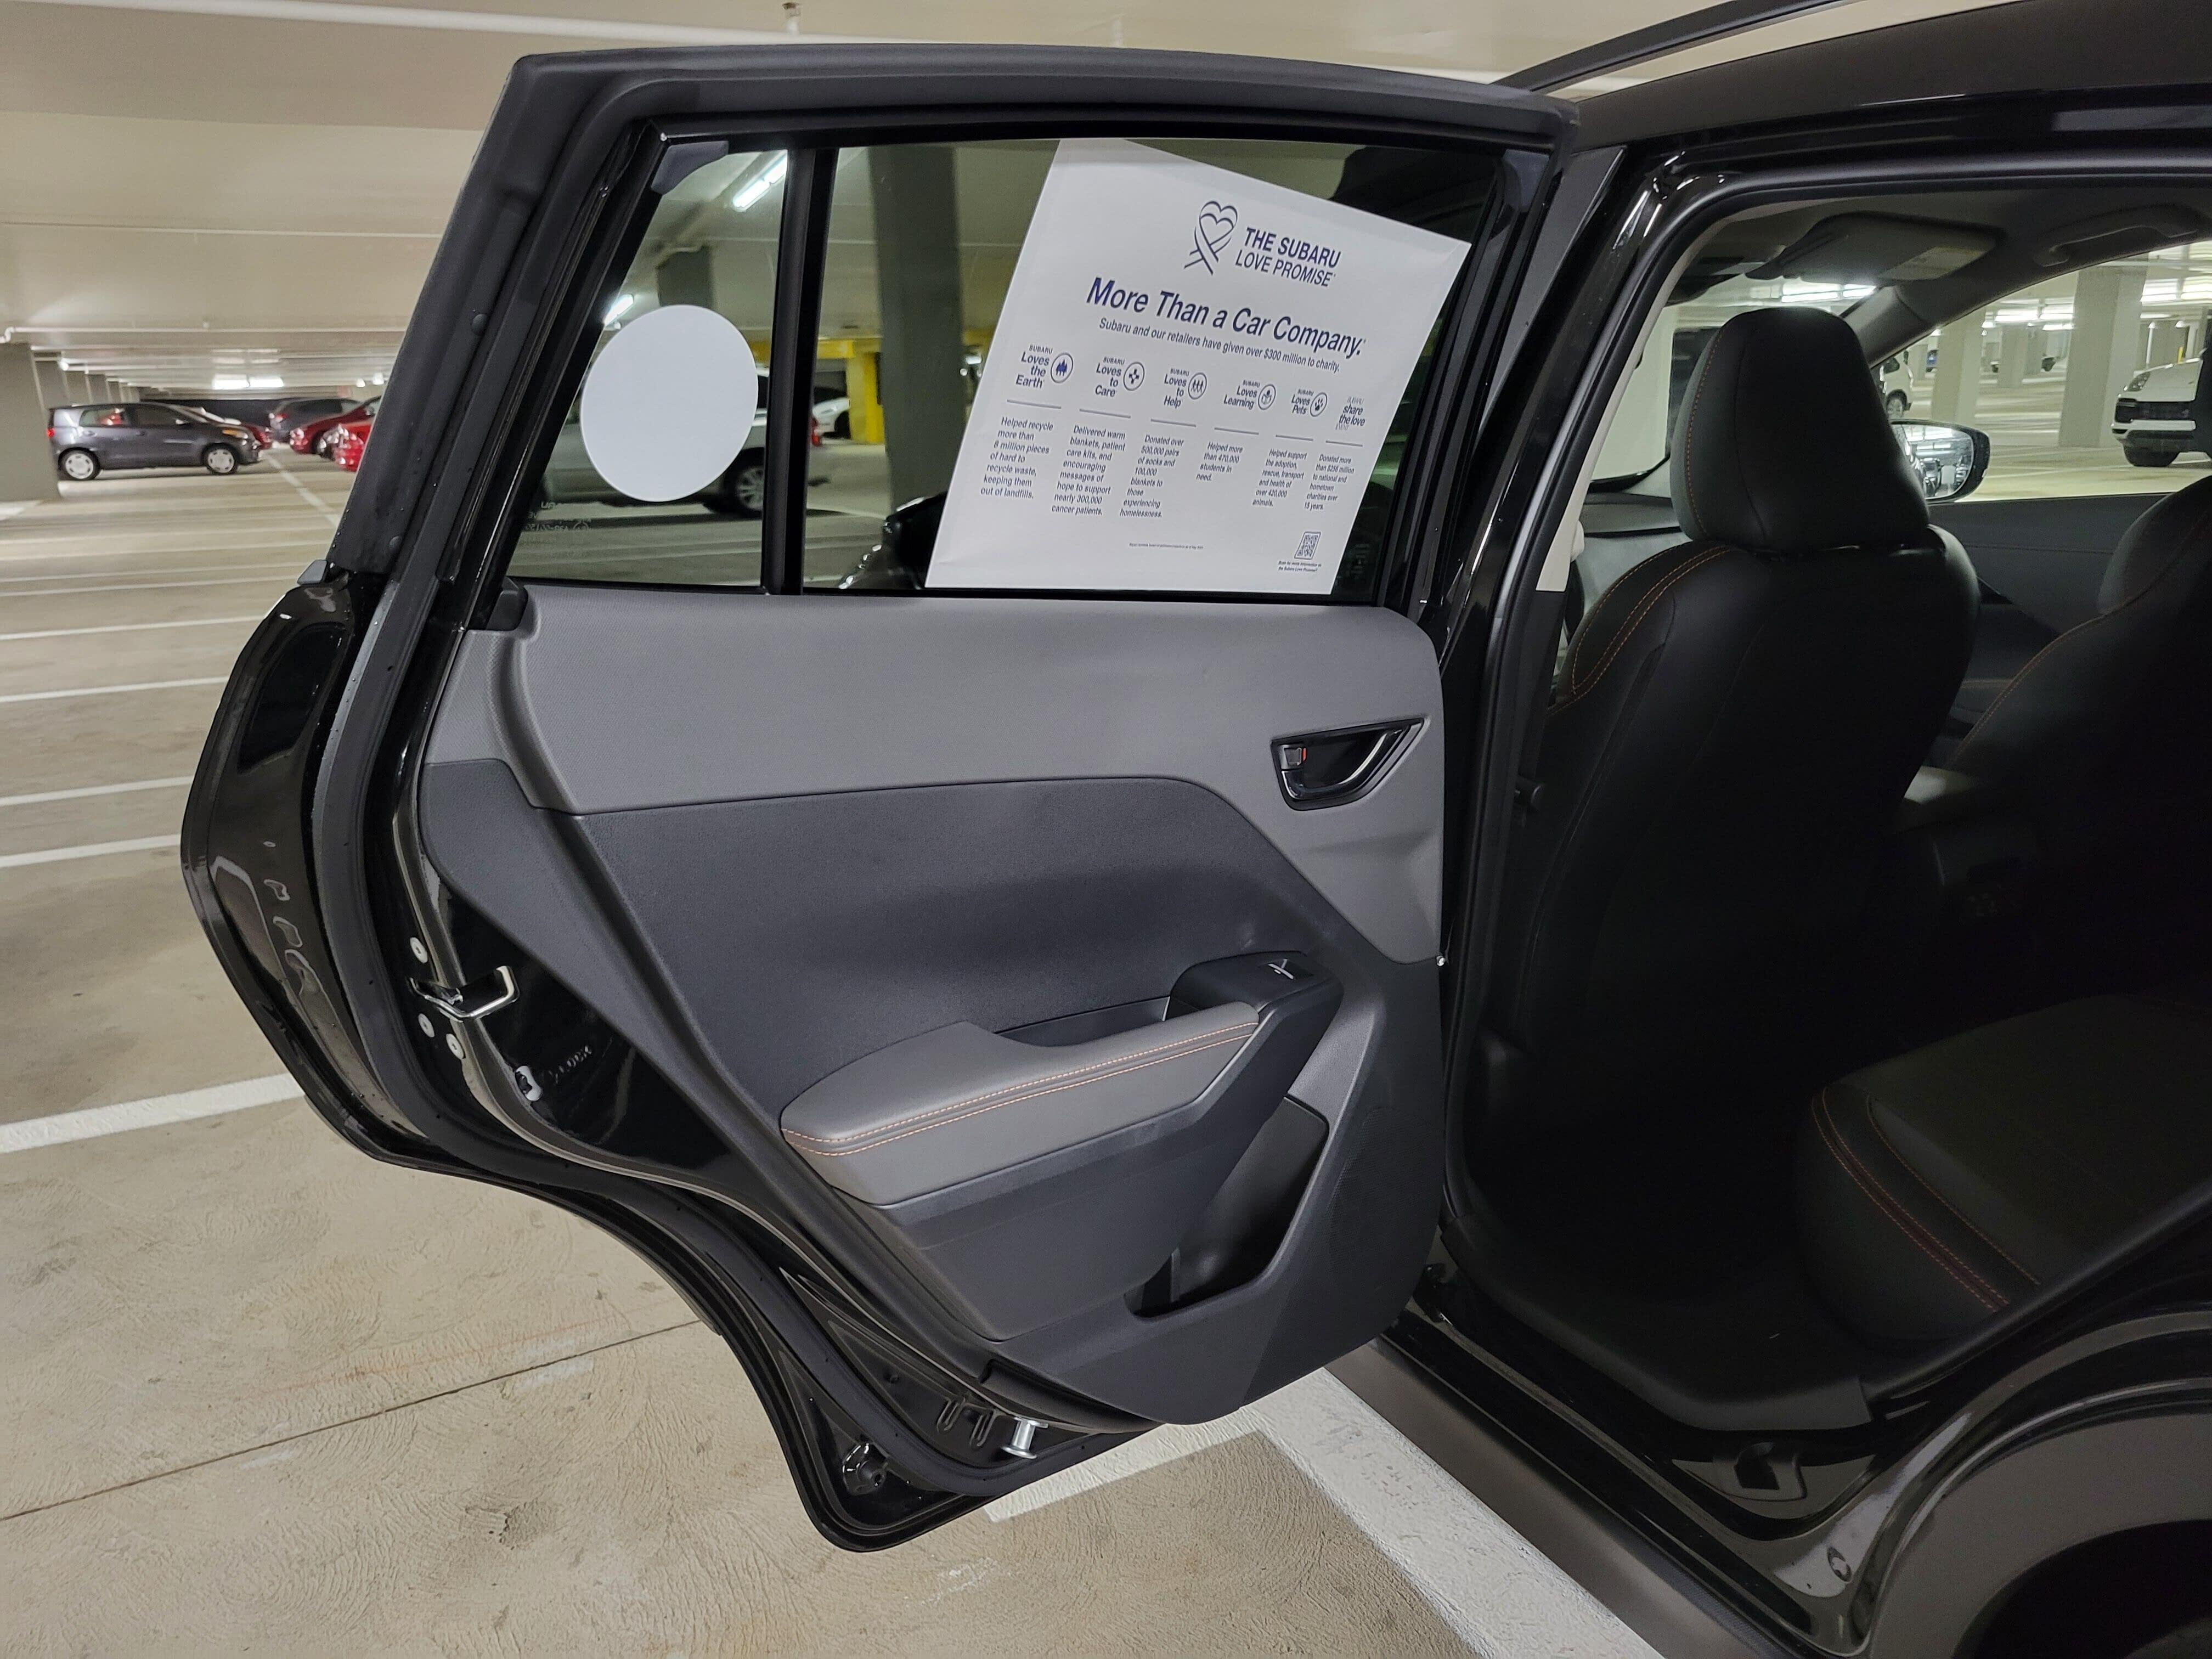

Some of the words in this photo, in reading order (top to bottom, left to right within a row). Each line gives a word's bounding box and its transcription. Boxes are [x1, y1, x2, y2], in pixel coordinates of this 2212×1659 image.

[1245, 227, 1276, 251] THE
[1278, 237, 1341, 268] SUBARU
[1235, 250, 1272, 273] LOVE
[1273, 259, 1333, 286] PROMISE
[1086, 277, 1149, 313] More
[1156, 291, 1209, 324] Than
[1212, 310, 1228, 328] a
[1233, 308, 1271, 336] Car
[1273, 317, 1362, 359] Company.
[1029, 345, 1053, 354] SUBARU
[1099, 317, 1131, 333] Subaru
[1133, 326, 1150, 336] and
[1151, 329, 1166, 339] our
[1167, 332, 1200, 346] retailers
[1202, 336, 1221, 349] have
[1222, 341, 1244, 353] given
[1246, 346, 1263, 357] over
[1264, 348, 1282, 360] $300
[1282, 353, 1306, 365] million
[1308, 357, 1314, 366] to
[1316, 358, 1340, 374] charity.
[1021, 351, 1049, 366] Loves
[1103, 357, 1125, 365] SUBARU
[1031, 365, 1046, 377] the
[1096, 363, 1121, 377] Loves
[1170, 368, 1189, 376] SUBARU
[1015, 375, 1043, 389] Earth
[1110, 377, 1119, 387] to
[1164, 374, 1187, 387] Loves
[1095, 385, 1115, 397] Care
[1176, 387, 1184, 397] to
[1237, 386, 1257, 398] Loves
[1164, 395, 1181, 408] Help
[1223, 394, 1254, 410] Learning
[1291, 394, 1311, 405] Loves
[1292, 404, 1307, 415] Pets
[1343, 404, 1363, 415] share
[1001, 417, 1027, 427] Helped
[1029, 420, 1053, 432] recycle
[1339, 414, 1350, 425] the
[1350, 415, 1365, 426] love
[998, 430, 1017, 438] more
[1018, 431, 1034, 441] than
[1074, 425, 1106, 437] Delivered
[1107, 431, 1125, 439] warm
[1070, 437, 1100, 448] blankets,
[1102, 441, 1125, 452] patient
[1145, 434, 1170, 445] Donated
[1000, 441, 1025, 452] million
[1026, 444, 1049, 454] pieces
[1165, 447, 1180, 457] pairs
[1207, 441, 1228, 452] Helped
[1000, 453, 1017, 462] hard
[1066, 449, 1081, 457] care
[1083, 450, 1097, 460] kits,
[1098, 452, 1112, 461] and
[1204, 452, 1217, 462] than
[1269, 448, 1288, 459] Helped
[1288, 451, 1307, 461] support
[1319, 454, 1339, 464] Donated
[1063, 460, 1106, 473] encouraging
[1138, 456, 1146, 465] of
[1146, 458, 1163, 466] socks
[1164, 459, 1176, 467] and
[1266, 458, 1274, 466] the
[1274, 460, 1297, 470] adoption,
[986, 464, 1013, 475] recycle
[1014, 466, 1037, 477] waste,
[1200, 462, 1224, 473] students
[1060, 471, 1094, 482] messages
[1096, 474, 1104, 483] of
[1196, 473, 1212, 482] need.
[1262, 469, 1280, 477] rescue,
[1281, 471, 1304, 480] transport
[983, 475, 1012, 487] keeping
[1014, 477, 1032, 487] them
[1131, 477, 1155, 487] blankets
[1271, 479, 1285, 488] health
[981, 487, 994, 495] out
[995, 487, 1003, 495] of
[1005, 488, 1034, 499] landfills.
[1057, 481, 1074, 492] hope
[1085, 484, 1111, 495] support
[1127, 488, 1143, 496] those
[1310, 483, 1334, 492] hometown
[1054, 494, 1075, 504] nearly
[1077, 495, 1102, 505] 300,000
[1123, 498, 1160, 509] experiencing
[1252, 499, 1273, 507] animals.
[1052, 505, 1074, 514] cancer
[1075, 506, 1102, 516] patients.
[1120, 508, 1162, 518] homelessness.
